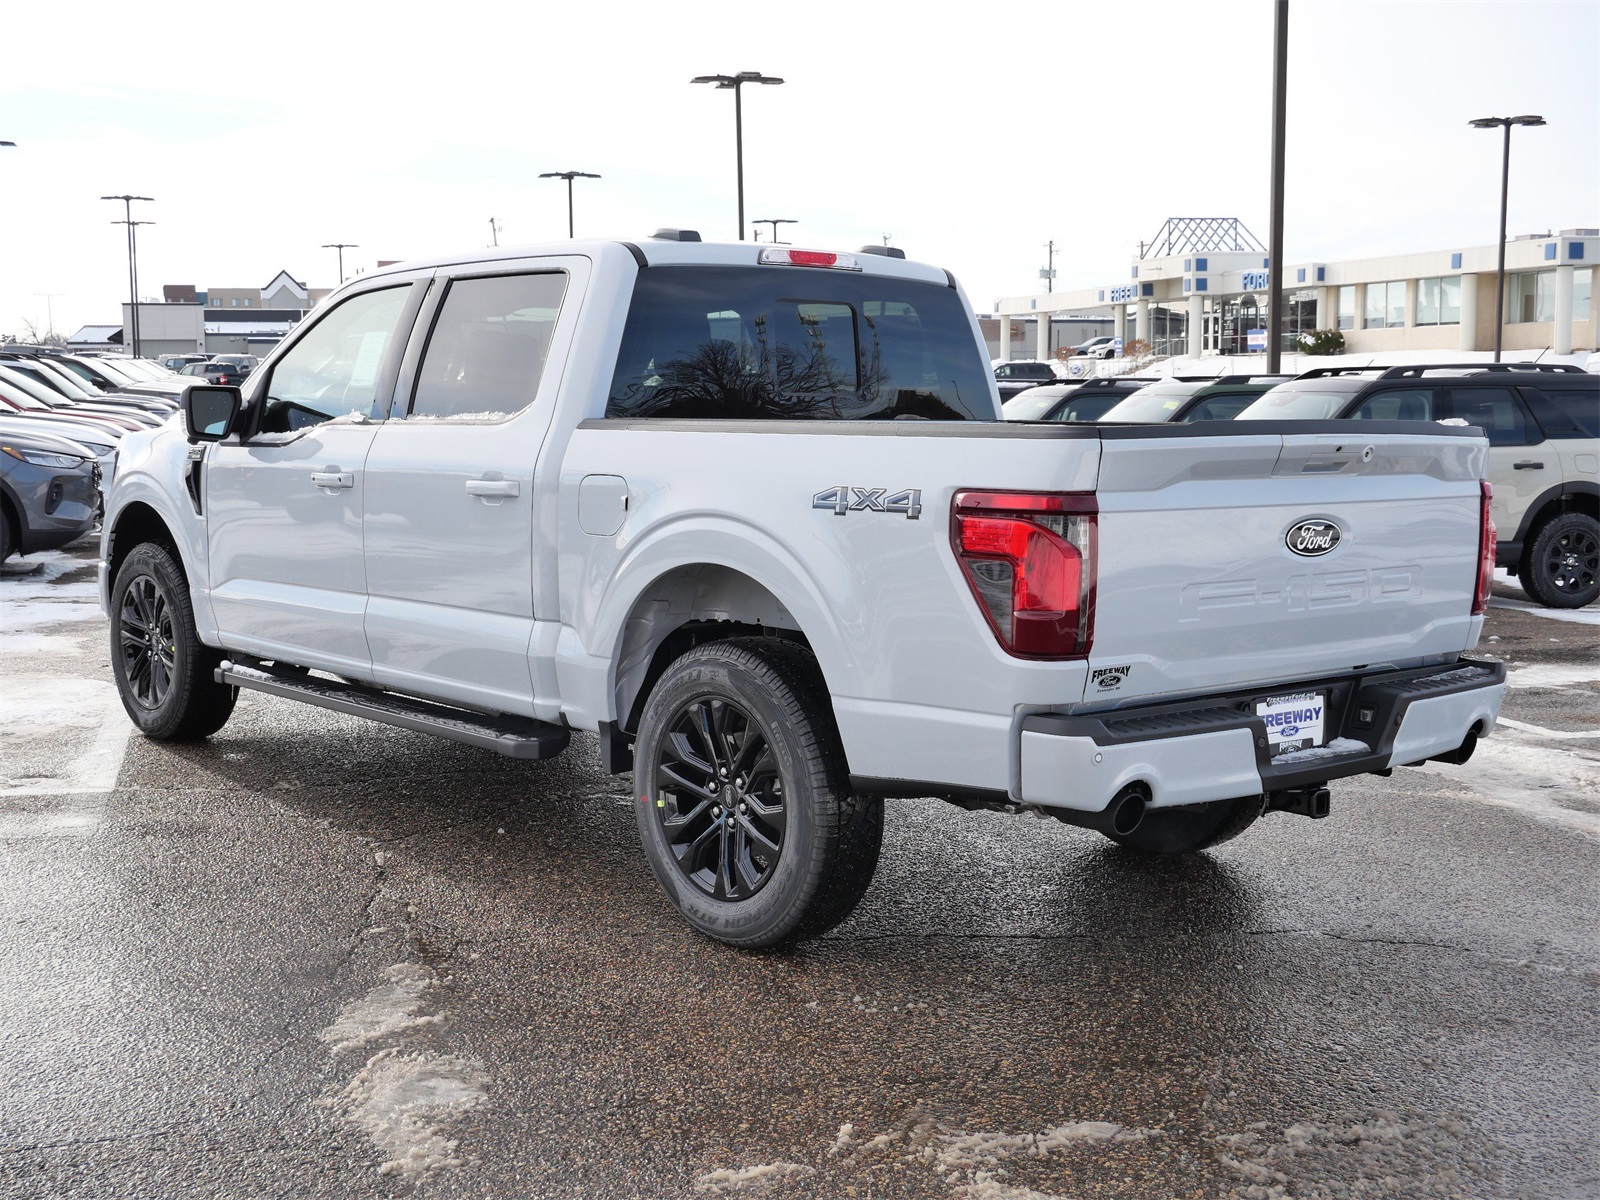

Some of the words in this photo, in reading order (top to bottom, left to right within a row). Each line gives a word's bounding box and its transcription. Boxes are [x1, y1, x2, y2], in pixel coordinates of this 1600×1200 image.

[1111, 287, 1131, 302] FREE
[1297, 525, 1332, 549] Ford
[1179, 565, 1423, 622] F-150
[1091, 665, 1131, 684] FREEWAY
[1261, 706, 1322, 728] REEWAY
